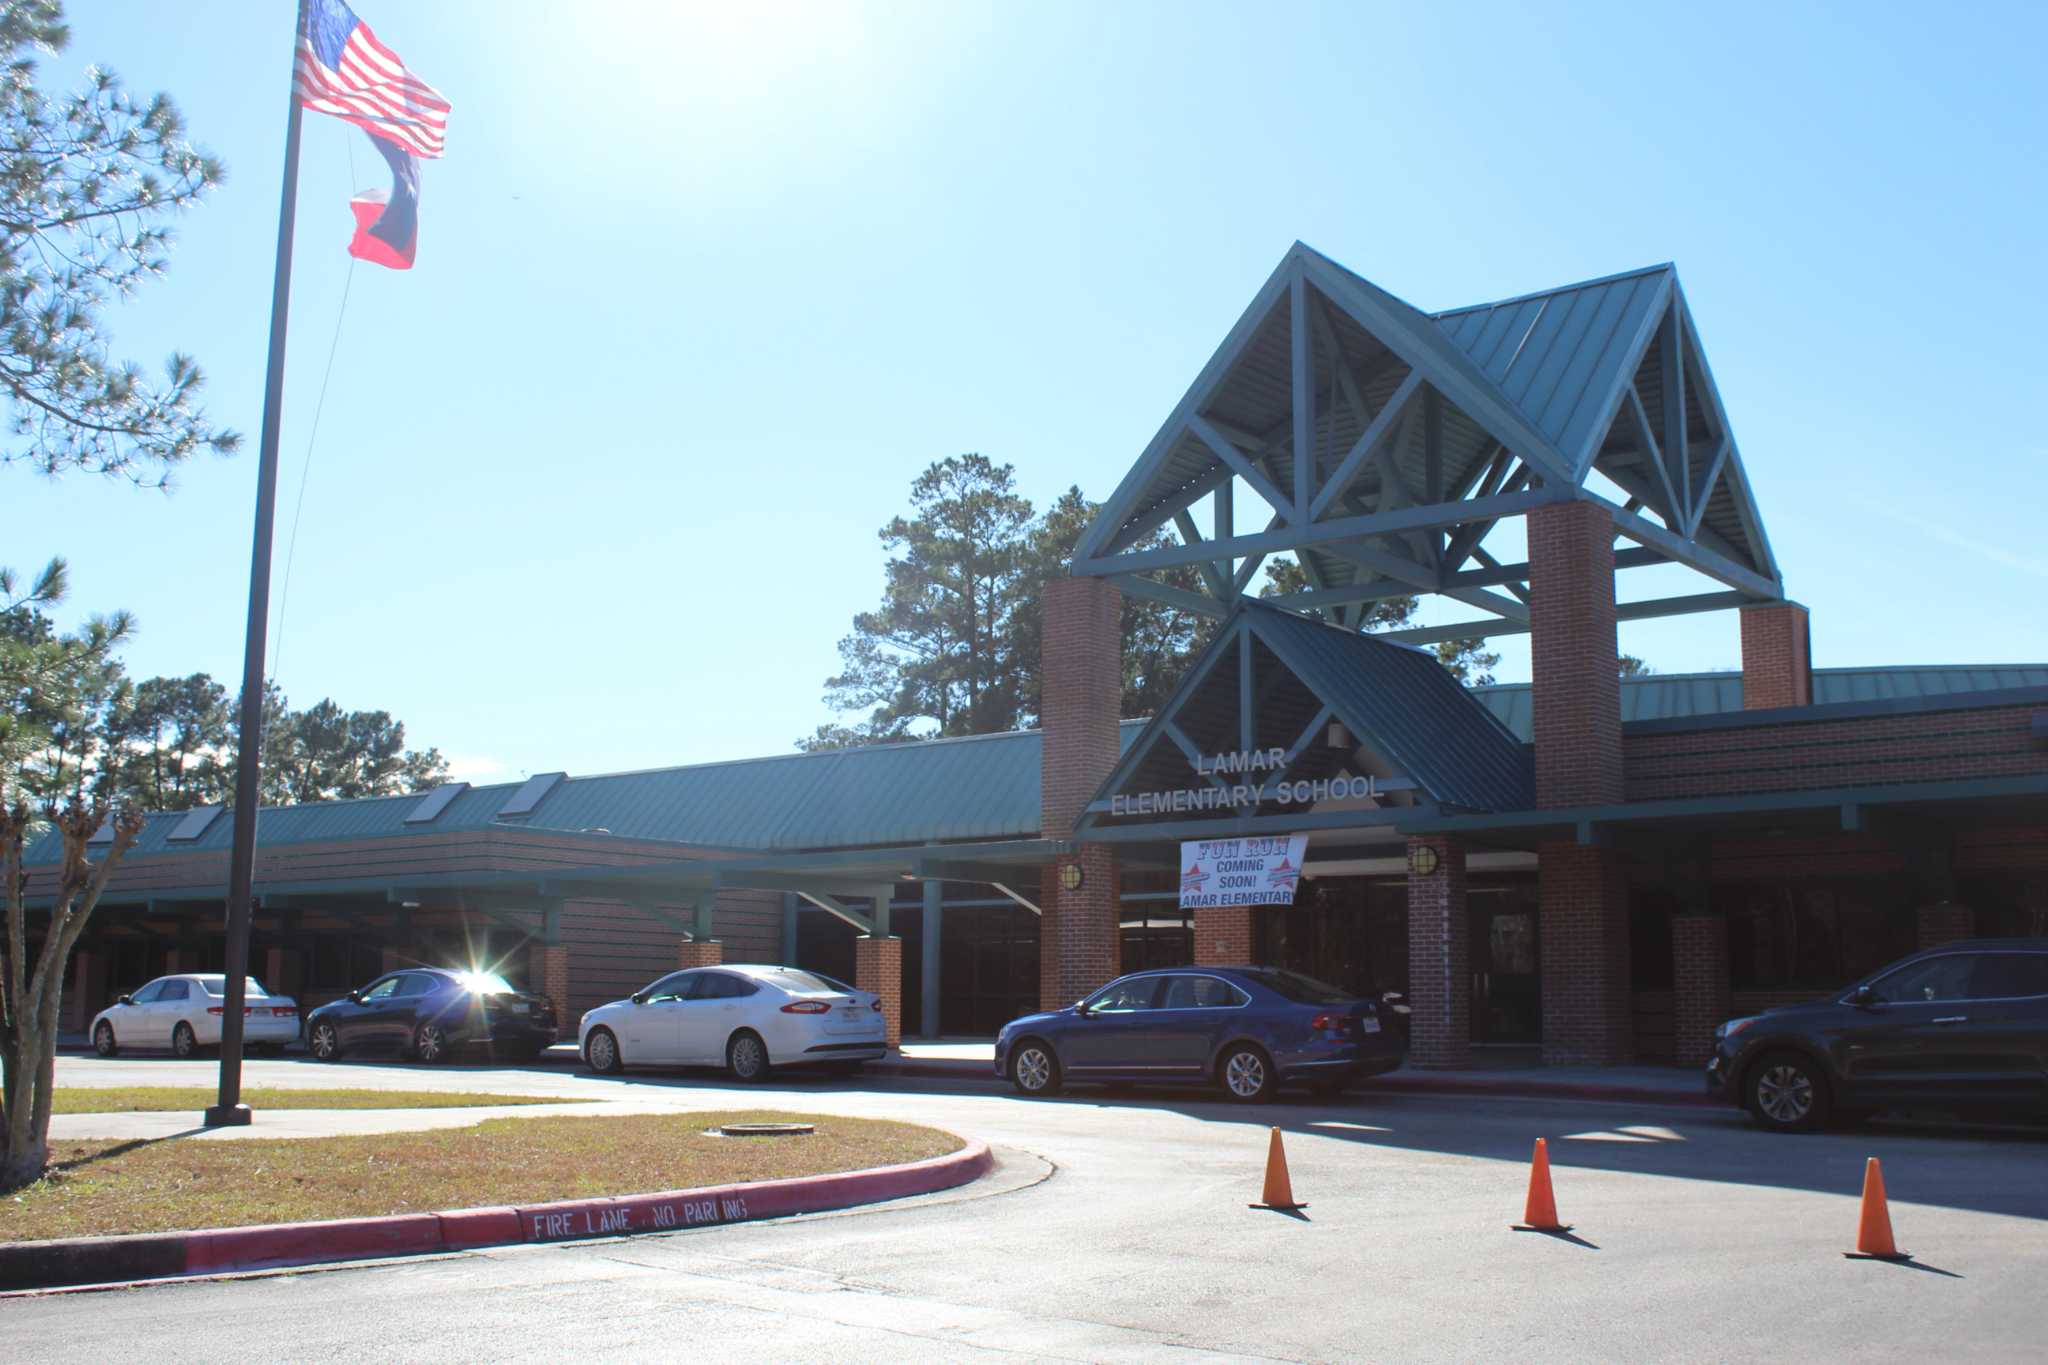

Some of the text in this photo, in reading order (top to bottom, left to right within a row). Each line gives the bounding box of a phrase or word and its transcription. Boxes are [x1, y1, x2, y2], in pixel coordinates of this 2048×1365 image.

[1197, 747, 1286, 776] LAMAR
[1111, 775, 1385, 816] ELEMENTARY SCHOOL
[1197, 837, 1290, 860] FUN RUN
[1216, 858, 1265, 873] COMING
[1218, 875, 1257, 889] SOON!
[1181, 890, 1293, 907] AMAR ELEMENTAR
[533, 1212, 576, 1238] FIRE
[585, 1208, 633, 1233] LANE
[653, 1205, 676, 1227] NO
